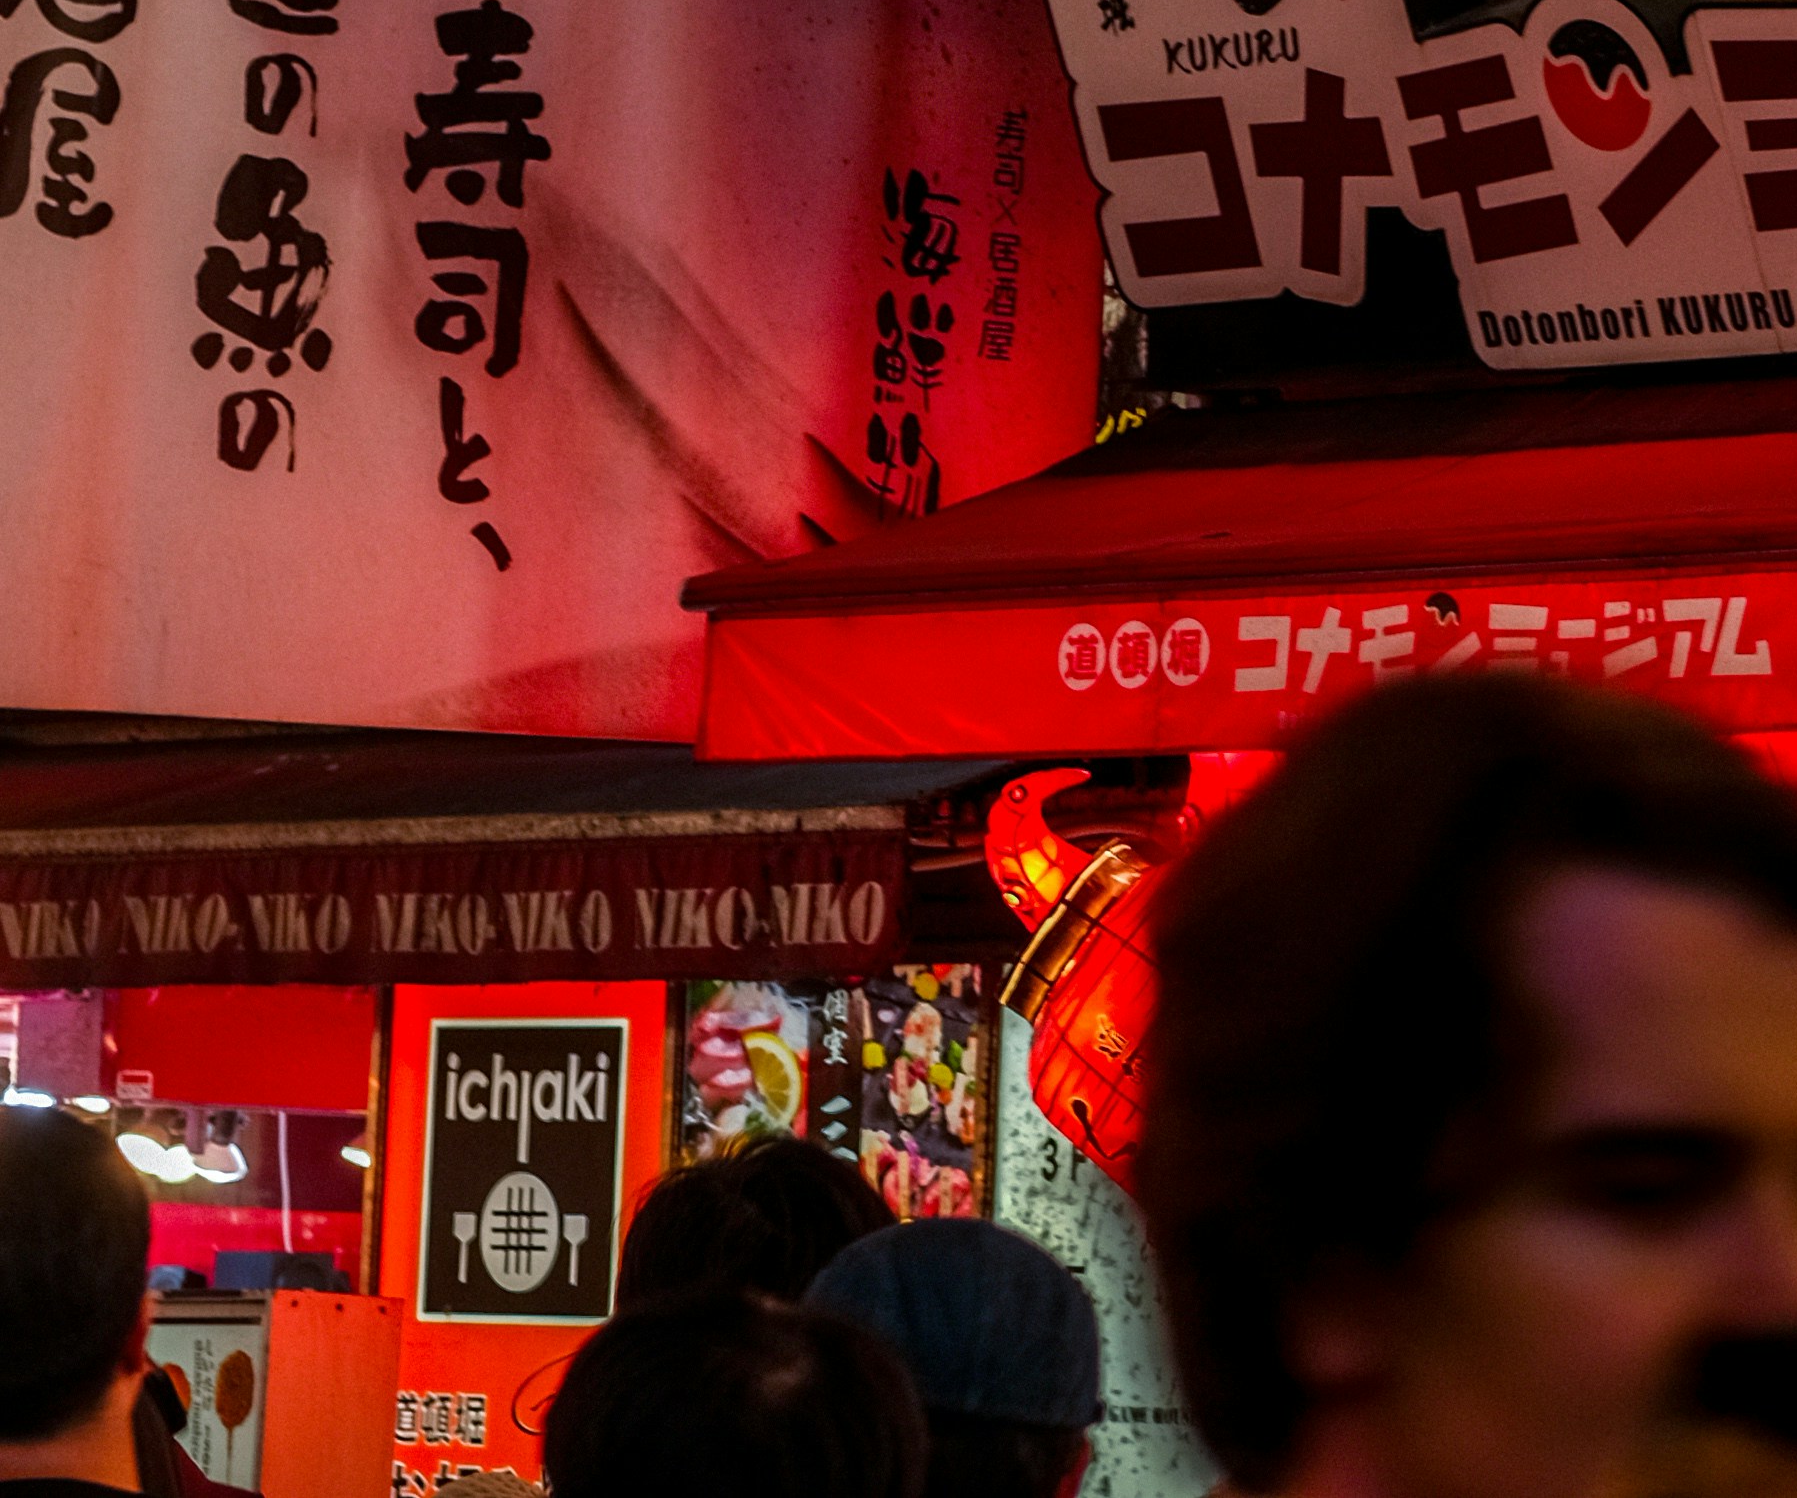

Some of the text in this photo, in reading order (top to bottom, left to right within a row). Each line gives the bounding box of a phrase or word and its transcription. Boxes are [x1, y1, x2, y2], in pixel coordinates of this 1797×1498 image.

[1161, 26, 1300, 75] KUKURU
[1476, 298, 1650, 348] Dotonbori
[1656, 288, 1796, 337] KUKURU
